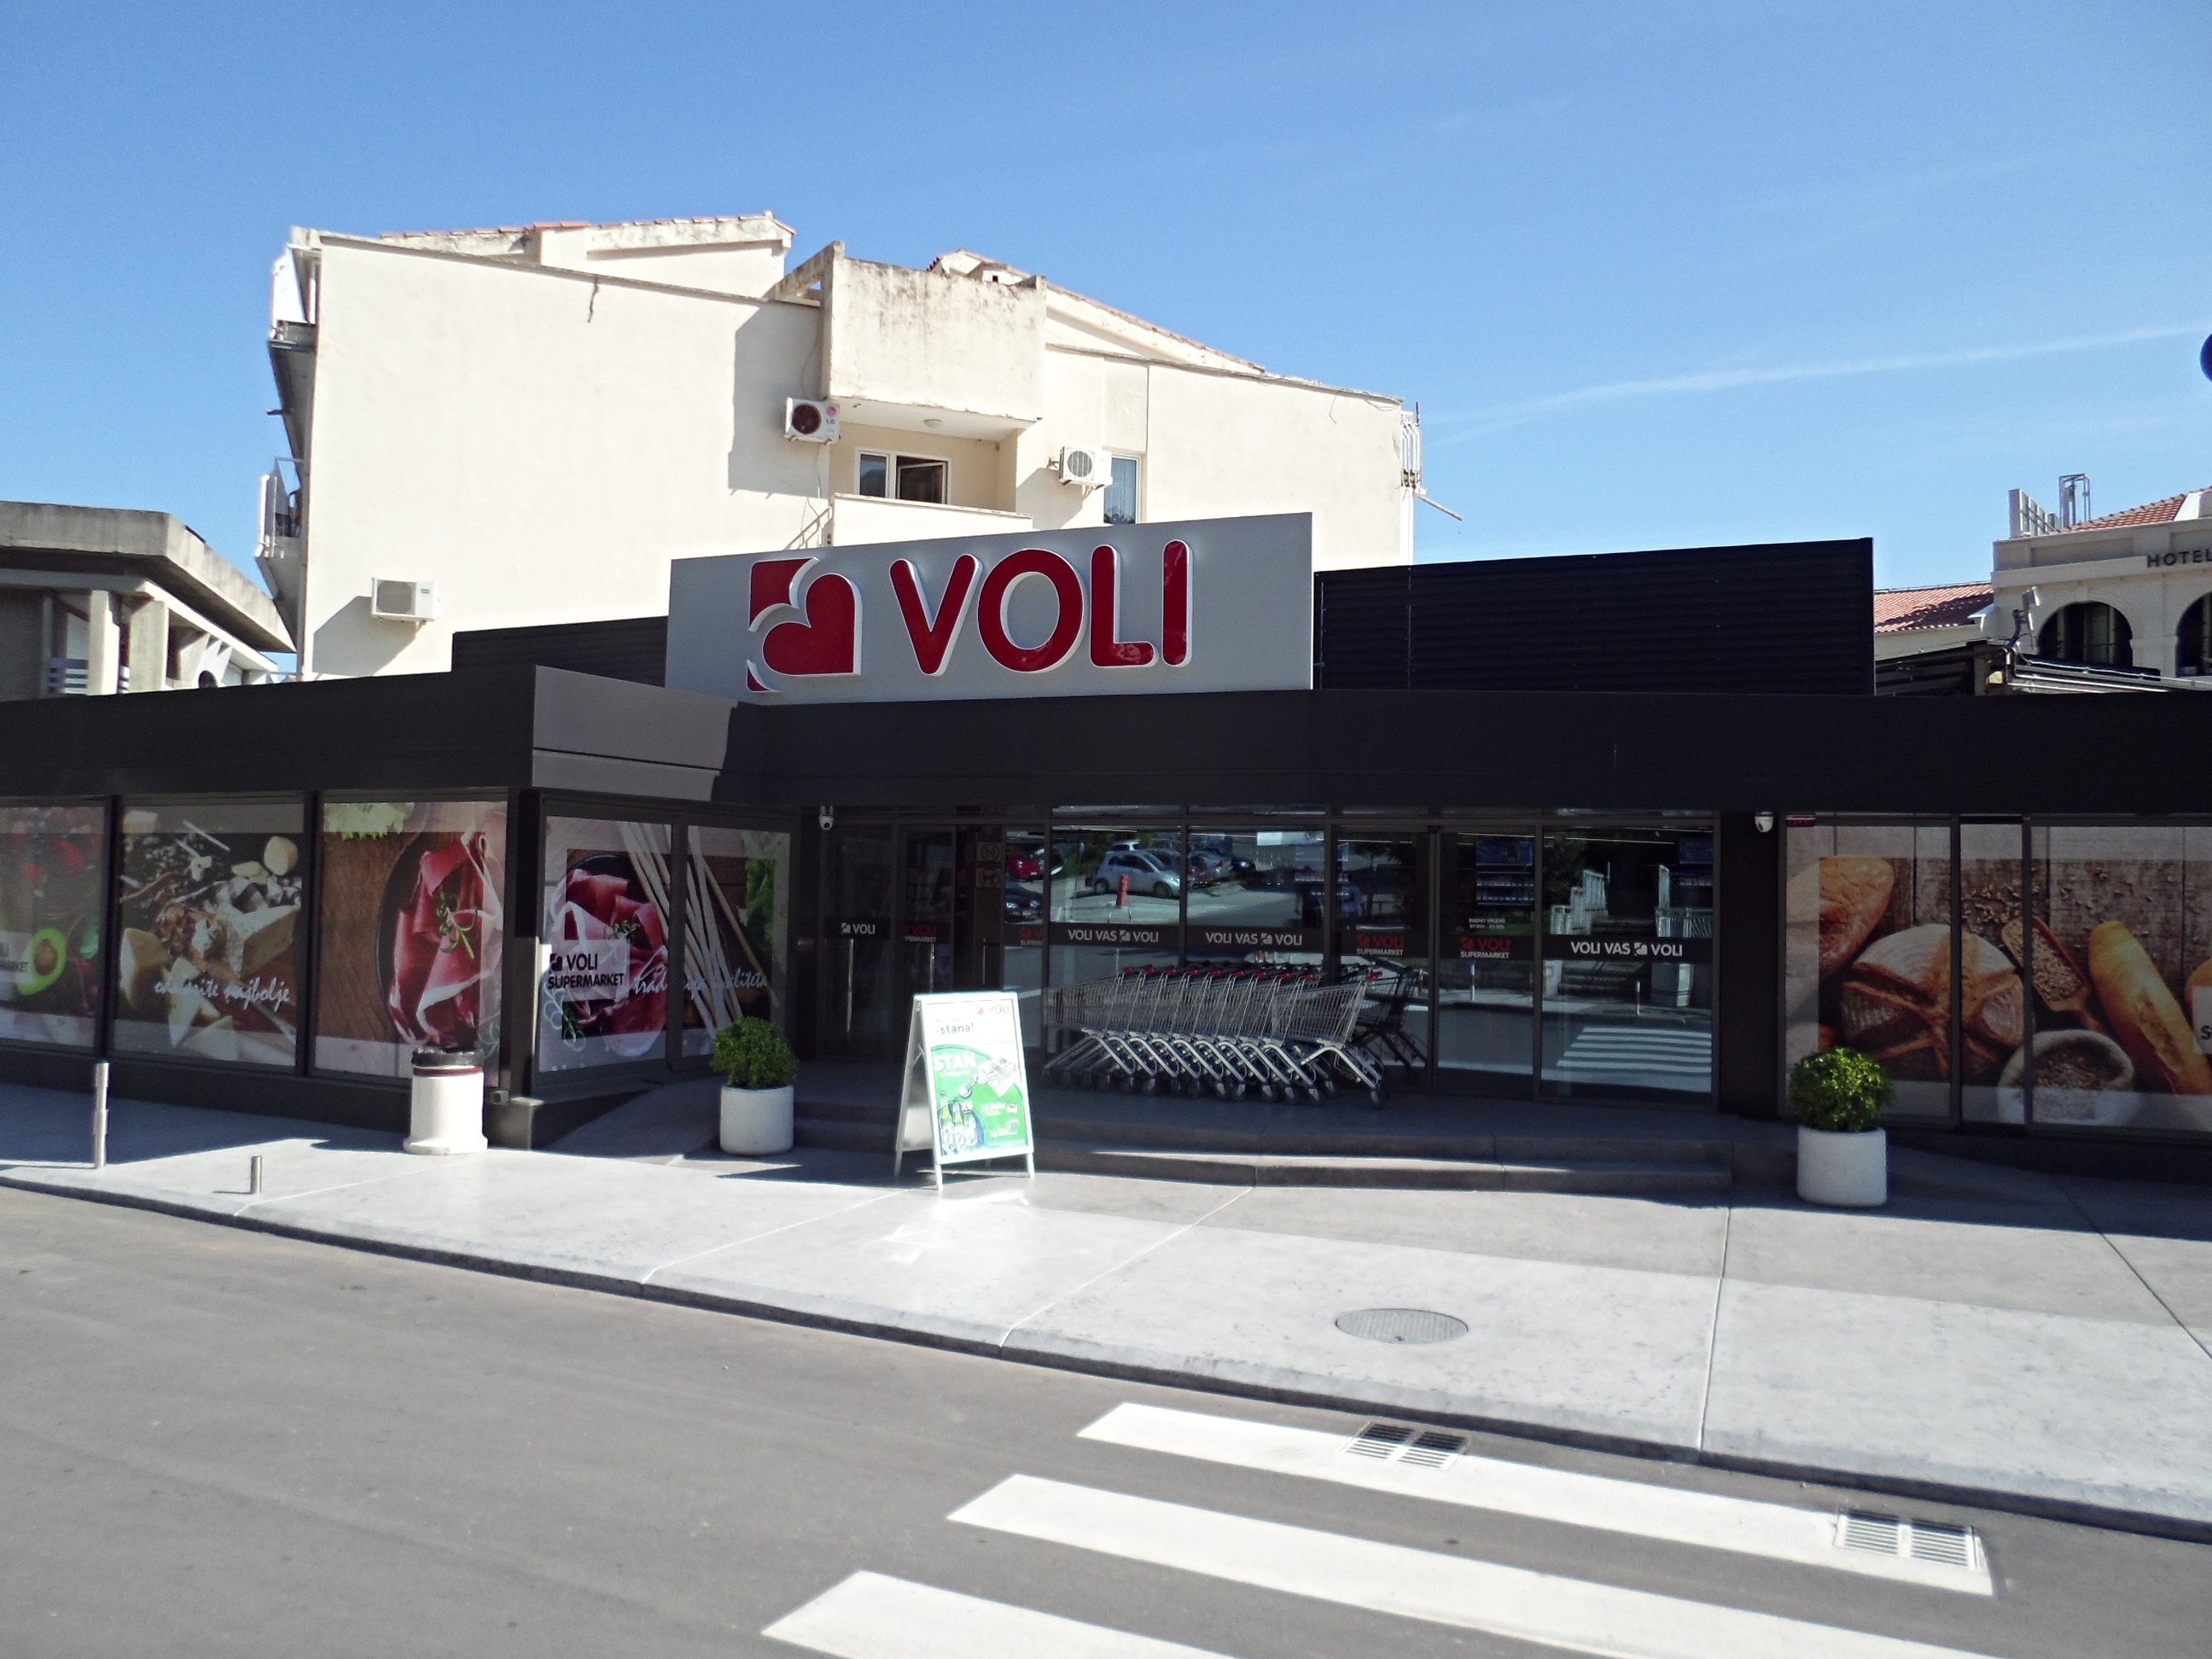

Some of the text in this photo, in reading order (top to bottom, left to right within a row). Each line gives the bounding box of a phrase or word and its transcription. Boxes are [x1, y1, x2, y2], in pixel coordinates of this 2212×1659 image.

[2146, 549, 2212, 568] HOTEL
[888, 538, 1194, 676] VOLI
[853, 923, 876, 934] VOLI
[1068, 929, 1159, 942] VOLI VAS VOLI
[1206, 932, 1302, 946] VOLI VAS VOLI
[1373, 935, 1405, 948] VOLI
[1476, 938, 1511, 951] VOLI
[1570, 941, 1683, 957] VOLI VAS VOLI
[1357, 948, 1404, 957] SUPERMARKET
[1460, 951, 1510, 959] SUPERMARKET
[567, 953, 597, 970] VOLI
[548, 972, 625, 990] SUPERMARKET
[988, 1004, 1010, 1014] VOLI
[940, 1022, 975, 1034] stana!
[933, 1053, 977, 1072] STAN
